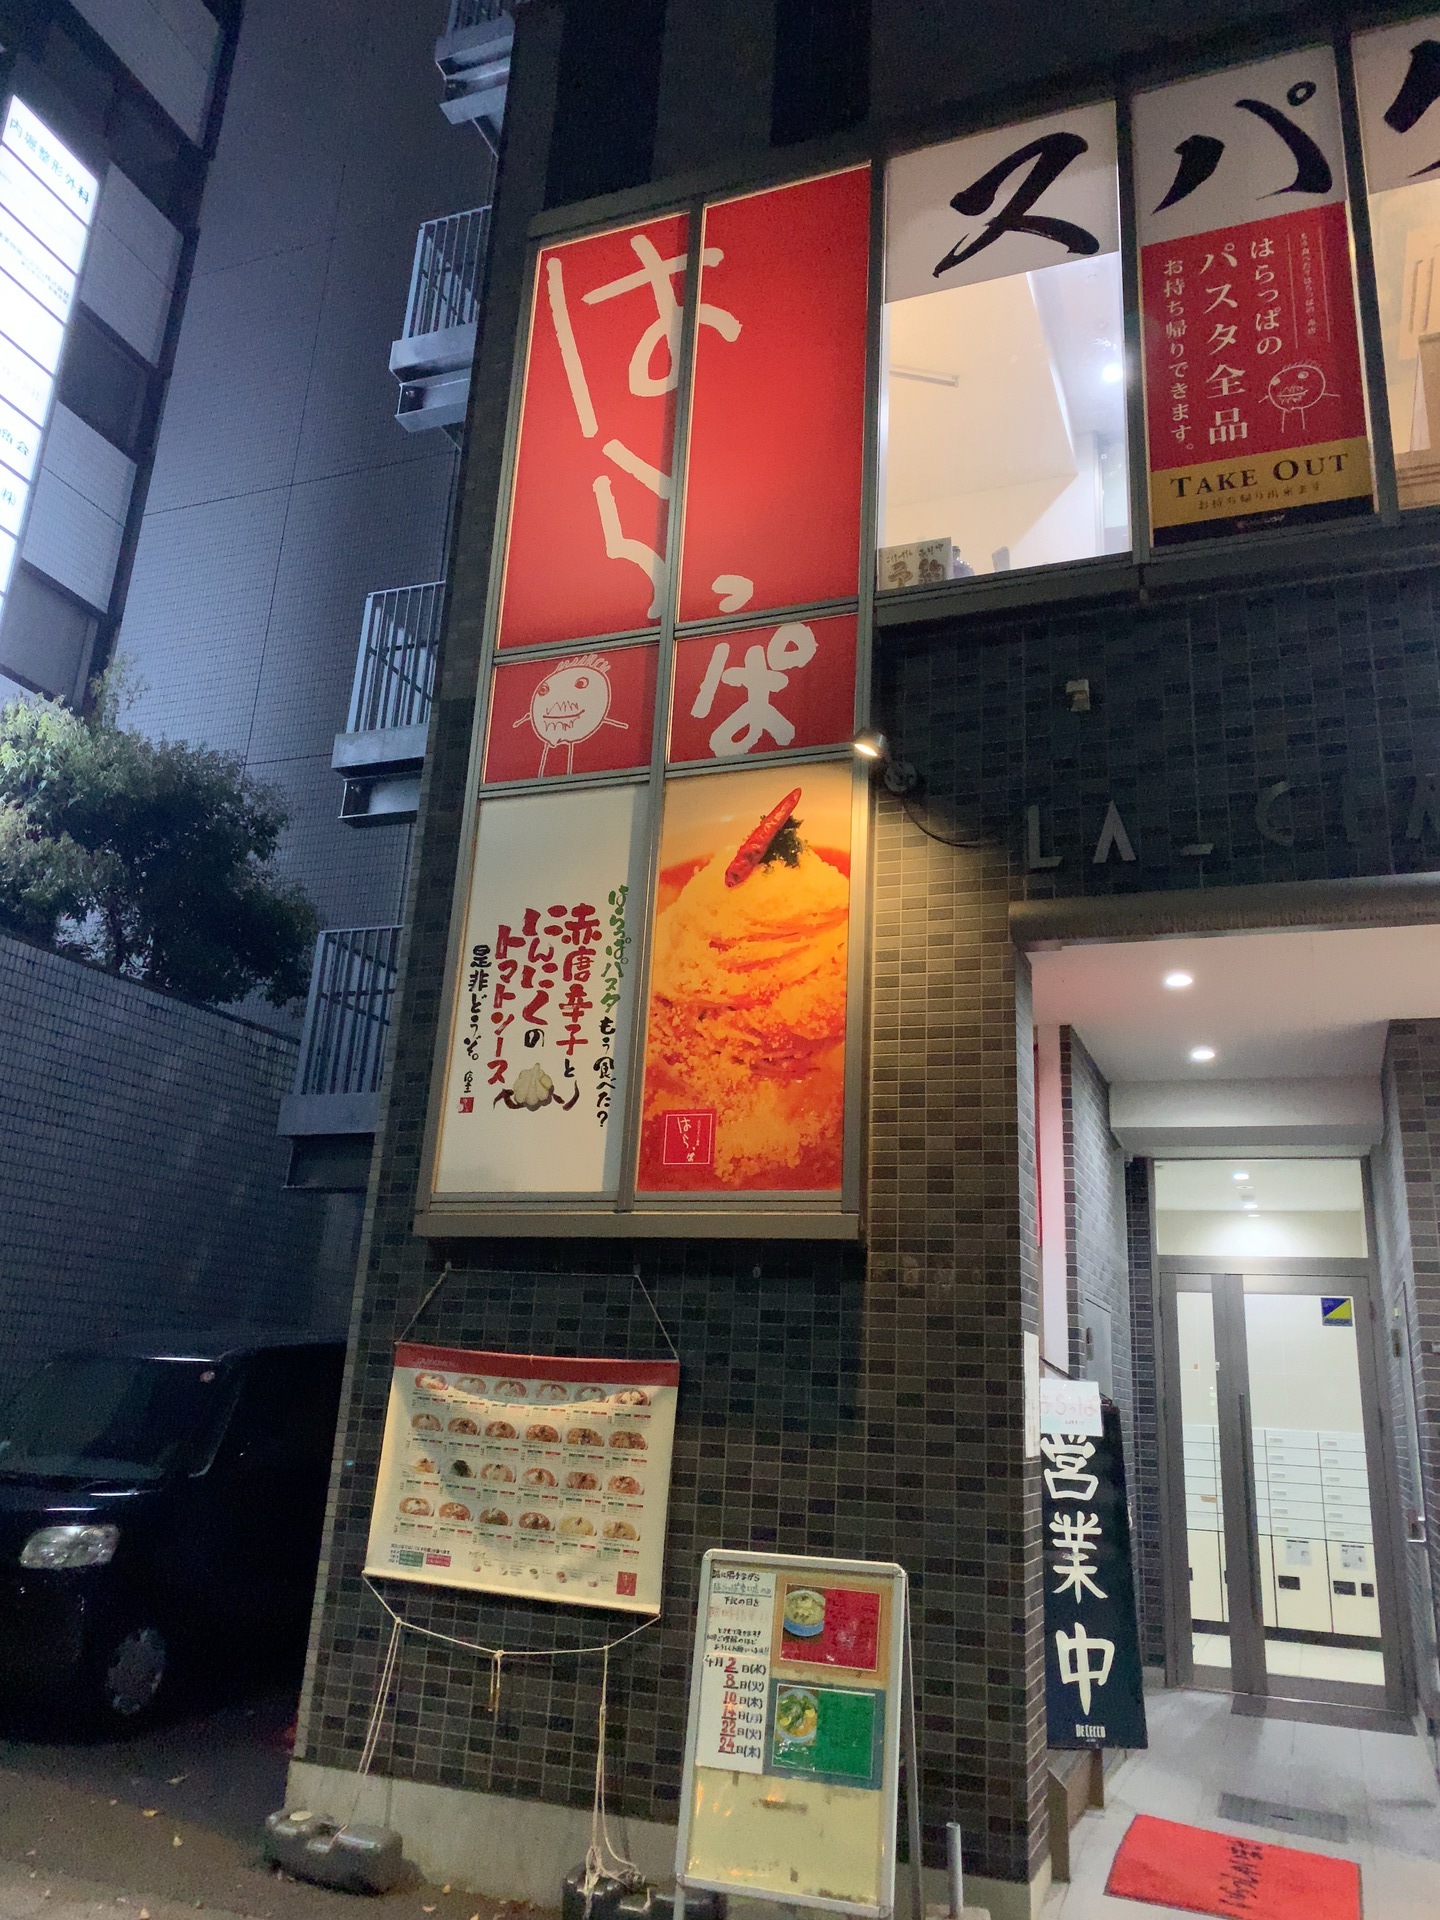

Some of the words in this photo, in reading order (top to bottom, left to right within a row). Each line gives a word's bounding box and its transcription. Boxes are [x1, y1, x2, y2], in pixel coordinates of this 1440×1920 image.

[9, 117, 90, 205] 内堀整形外科
[1163, 259, 1195, 451] お持ち帰りできます。
[1199, 242, 1249, 446] パスタ全品
[1250, 237, 1283, 355] はらっぱの
[546, 234, 819, 757] はらっぱ
[1170, 469, 1258, 499] TAKE
[1272, 452, 1349, 482] OUT
[486, 924, 527, 1086] トマトソース
[520, 904, 568, 1049] にんにくの
[555, 902, 603, 1079] 赤唐辛子と
[1040, 1433, 1116, 1717] 営業中
